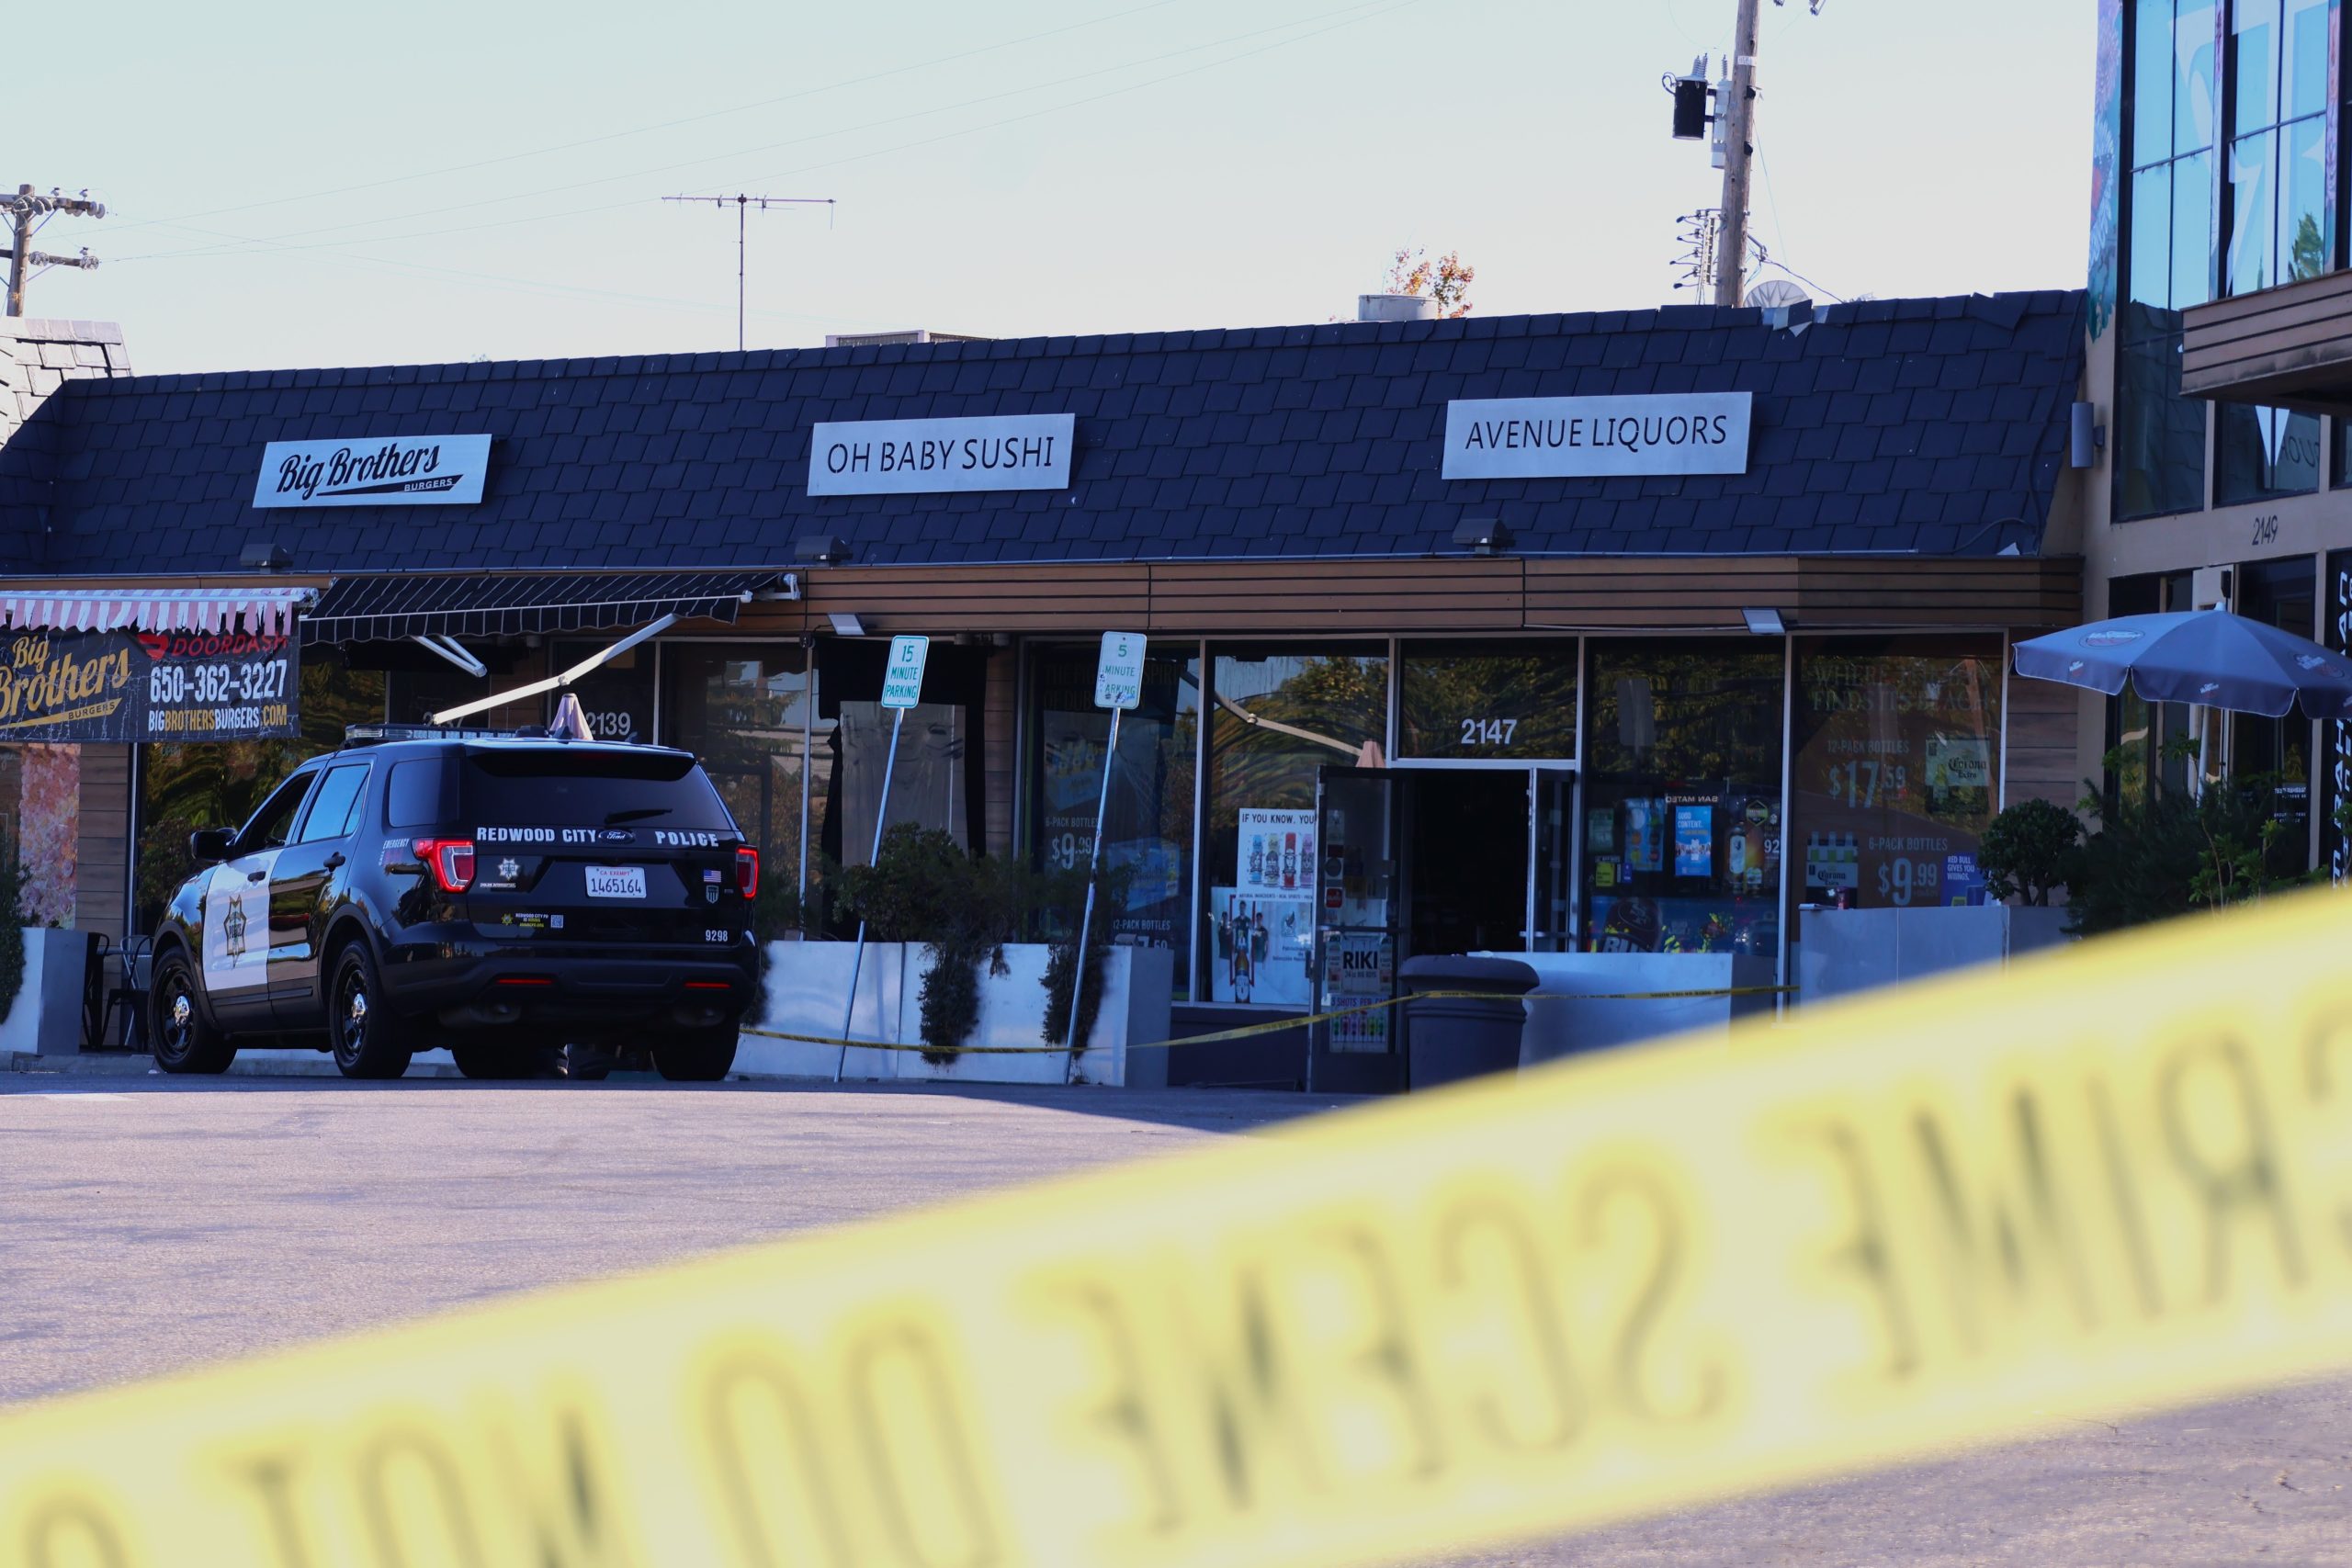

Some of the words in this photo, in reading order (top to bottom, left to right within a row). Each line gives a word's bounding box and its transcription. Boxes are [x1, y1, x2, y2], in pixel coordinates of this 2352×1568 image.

[1465, 419, 1583, 450] AVENUE
[1592, 415, 1727, 453] LIQUORS
[828, 443, 870, 474] OH
[880, 440, 956, 472] BABY
[962, 436, 1055, 470] SUSHI
[277, 454, 324, 501] Big
[326, 443, 440, 487] Brothers
[404, 478, 453, 491] BURGERS
[2252, 514, 2278, 546] 2149
[171, 632, 288, 657] DOORDASH
[1118, 644, 1127, 658] 5
[13, 636, 51, 672] Big
[902, 645, 915, 662] 15
[891, 666, 919, 681] MINUTE
[1105, 665, 1136, 677] MINUTE
[150, 660, 288, 704] 650-362-3227
[1101, 683, 1136, 695] ARKING
[885, 684, 917, 700] PARKING
[68, 702, 116, 719] BURGERS
[148, 705, 288, 732] BIGBROTHERSBURGERS.COM
[586, 712, 631, 736] 2139
[1461, 719, 1517, 745] 2147
[1868, 739, 1911, 753] BOTTLES
[1948, 756, 1986, 771] Corona
[1242, 814, 1250, 823] IF
[1252, 814, 1267, 823] YOU
[477, 827, 555, 842] REDWOOD
[562, 829, 596, 842] CITY
[606, 830, 627, 840] Ford
[655, 830, 719, 848] POLICE
[1869, 837, 1905, 851] 6-PACK
[1906, 837, 1948, 852] BOTTLES
[1963, 864, 1975, 873] YOU
[591, 877, 642, 896] 1465164
[1878, 857, 1939, 906] $9.99
[1141, 919, 1171, 931] BOTTLES
[705, 929, 729, 942] 9298
[1343, 951, 1378, 969] RIKI
